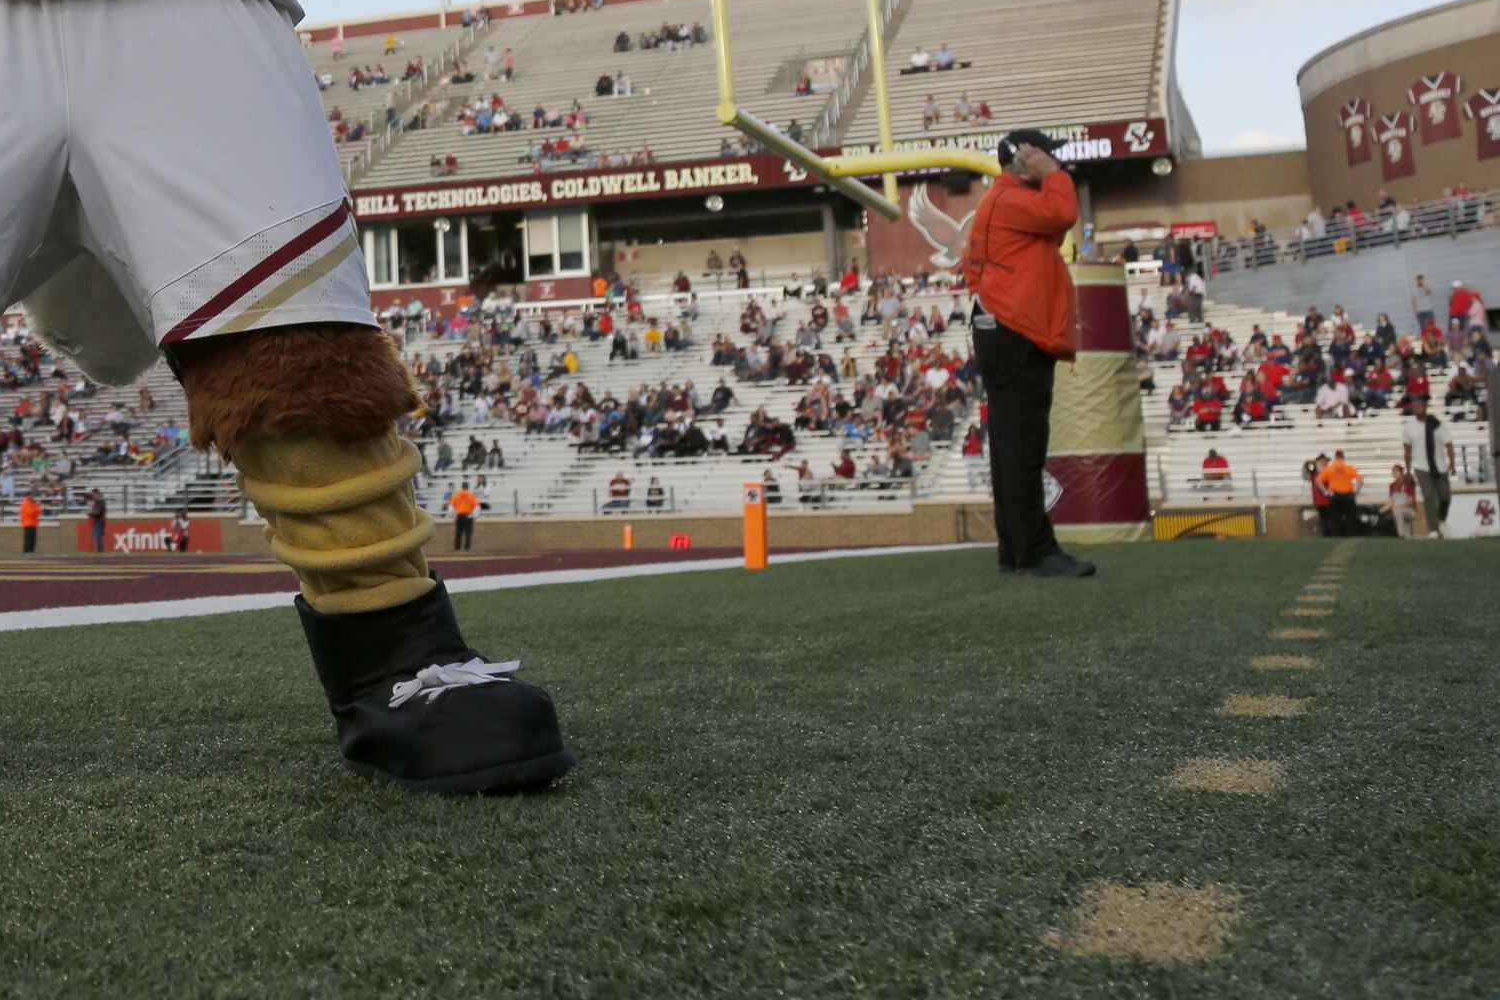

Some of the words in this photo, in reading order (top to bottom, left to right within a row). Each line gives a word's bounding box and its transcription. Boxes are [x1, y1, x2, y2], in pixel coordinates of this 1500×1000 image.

[356, 194, 399, 216] HILL
[402, 180, 548, 213] TECHNOLOGIES,
[551, 171, 660, 200] COLDWELL
[664, 162, 759, 191] BANKER,
[114, 527, 173, 554] xfinit
